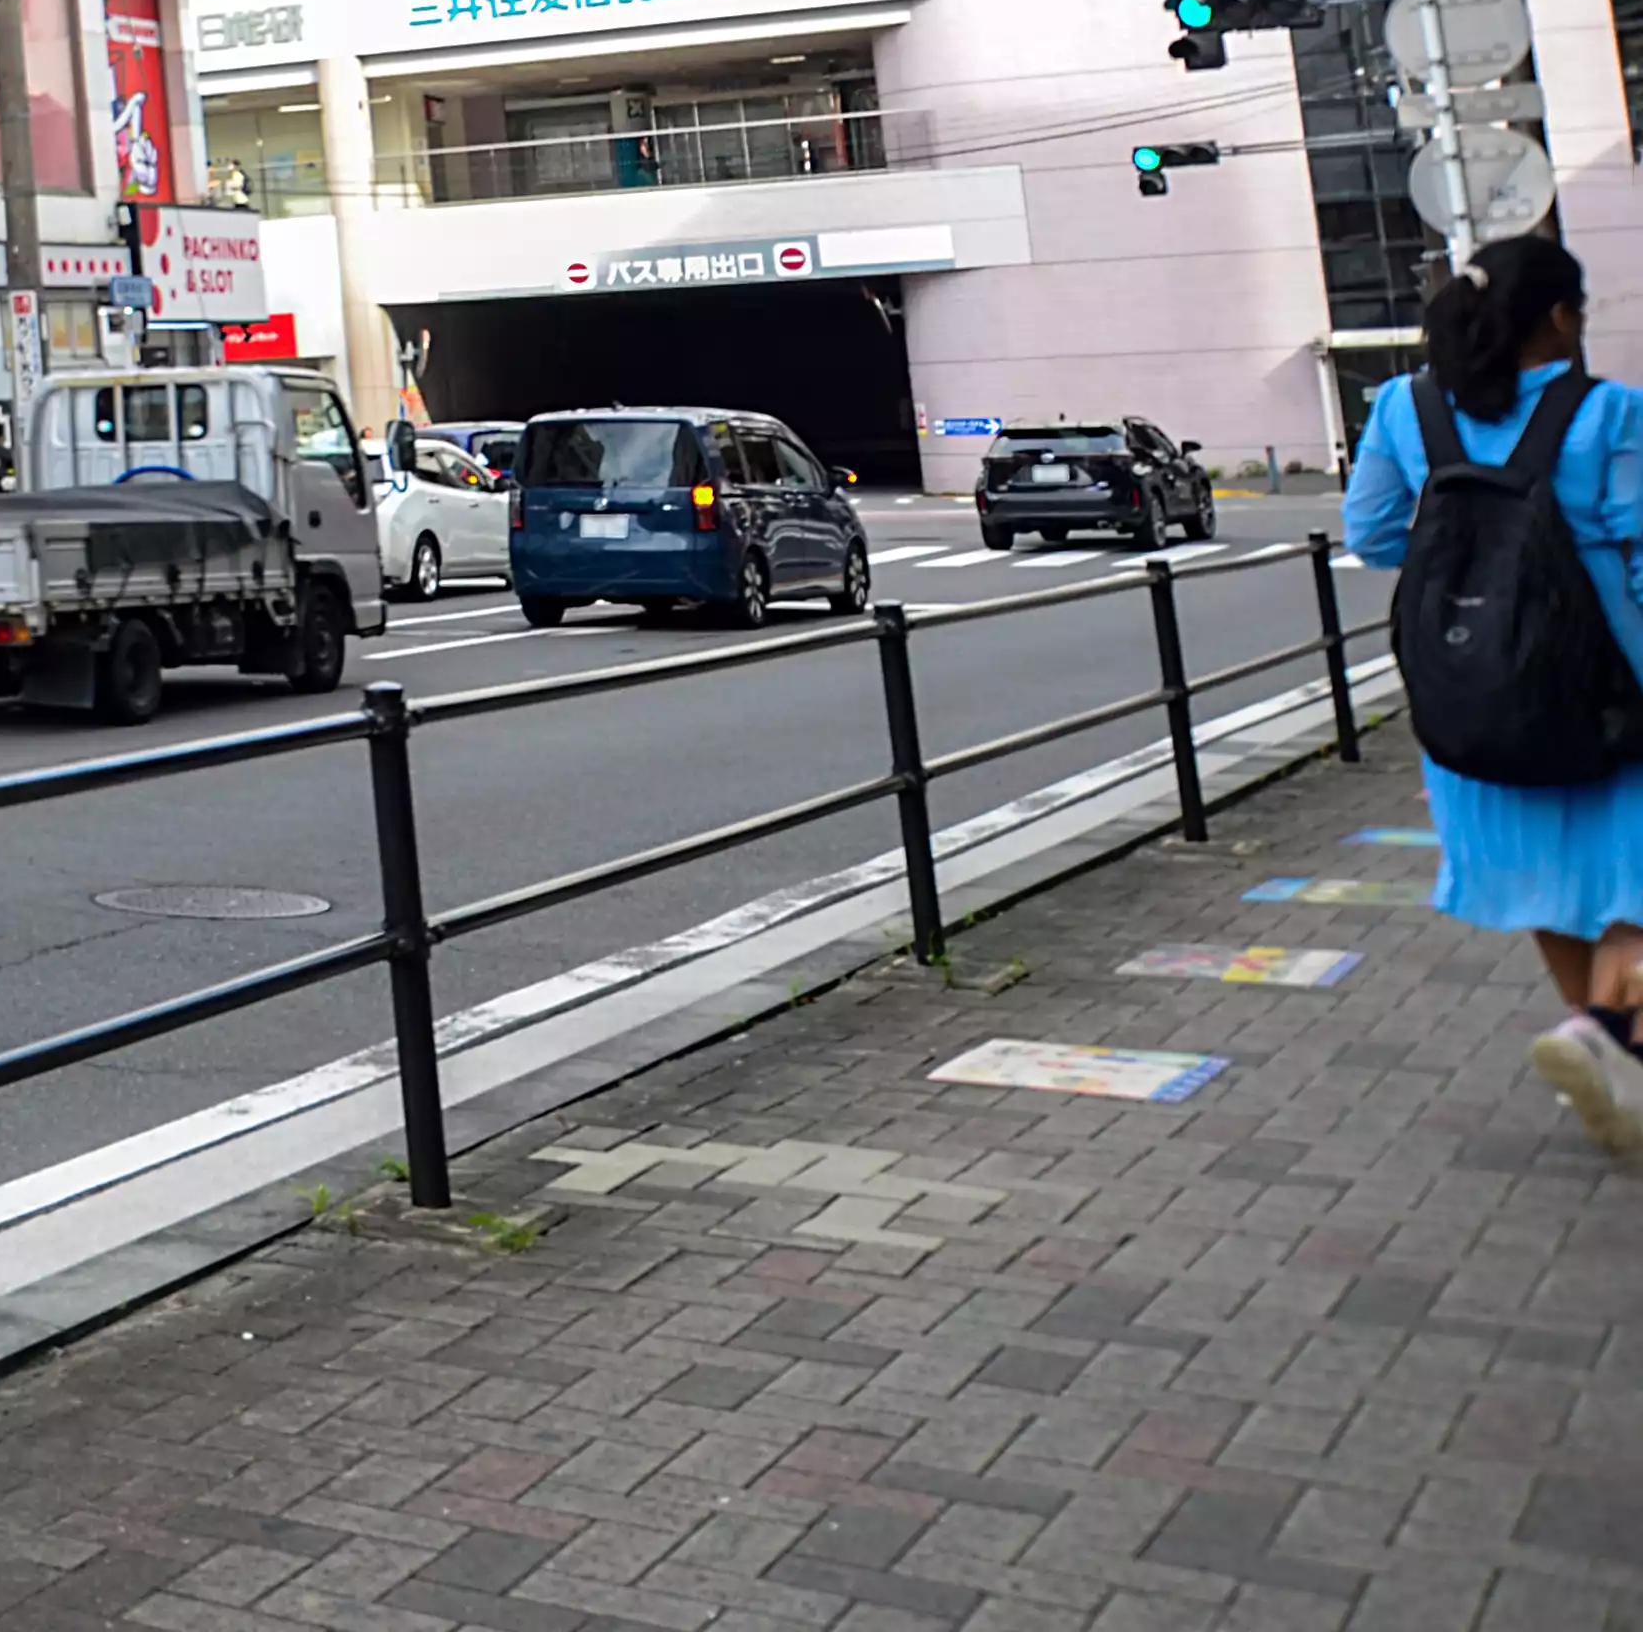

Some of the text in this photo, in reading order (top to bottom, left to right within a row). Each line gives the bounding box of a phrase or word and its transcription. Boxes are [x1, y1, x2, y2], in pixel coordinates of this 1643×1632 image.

[182, 235, 259, 262] PACHINKO
[200, 269, 235, 294] SLOT
[606, 252, 765, 286] バス専用出口
